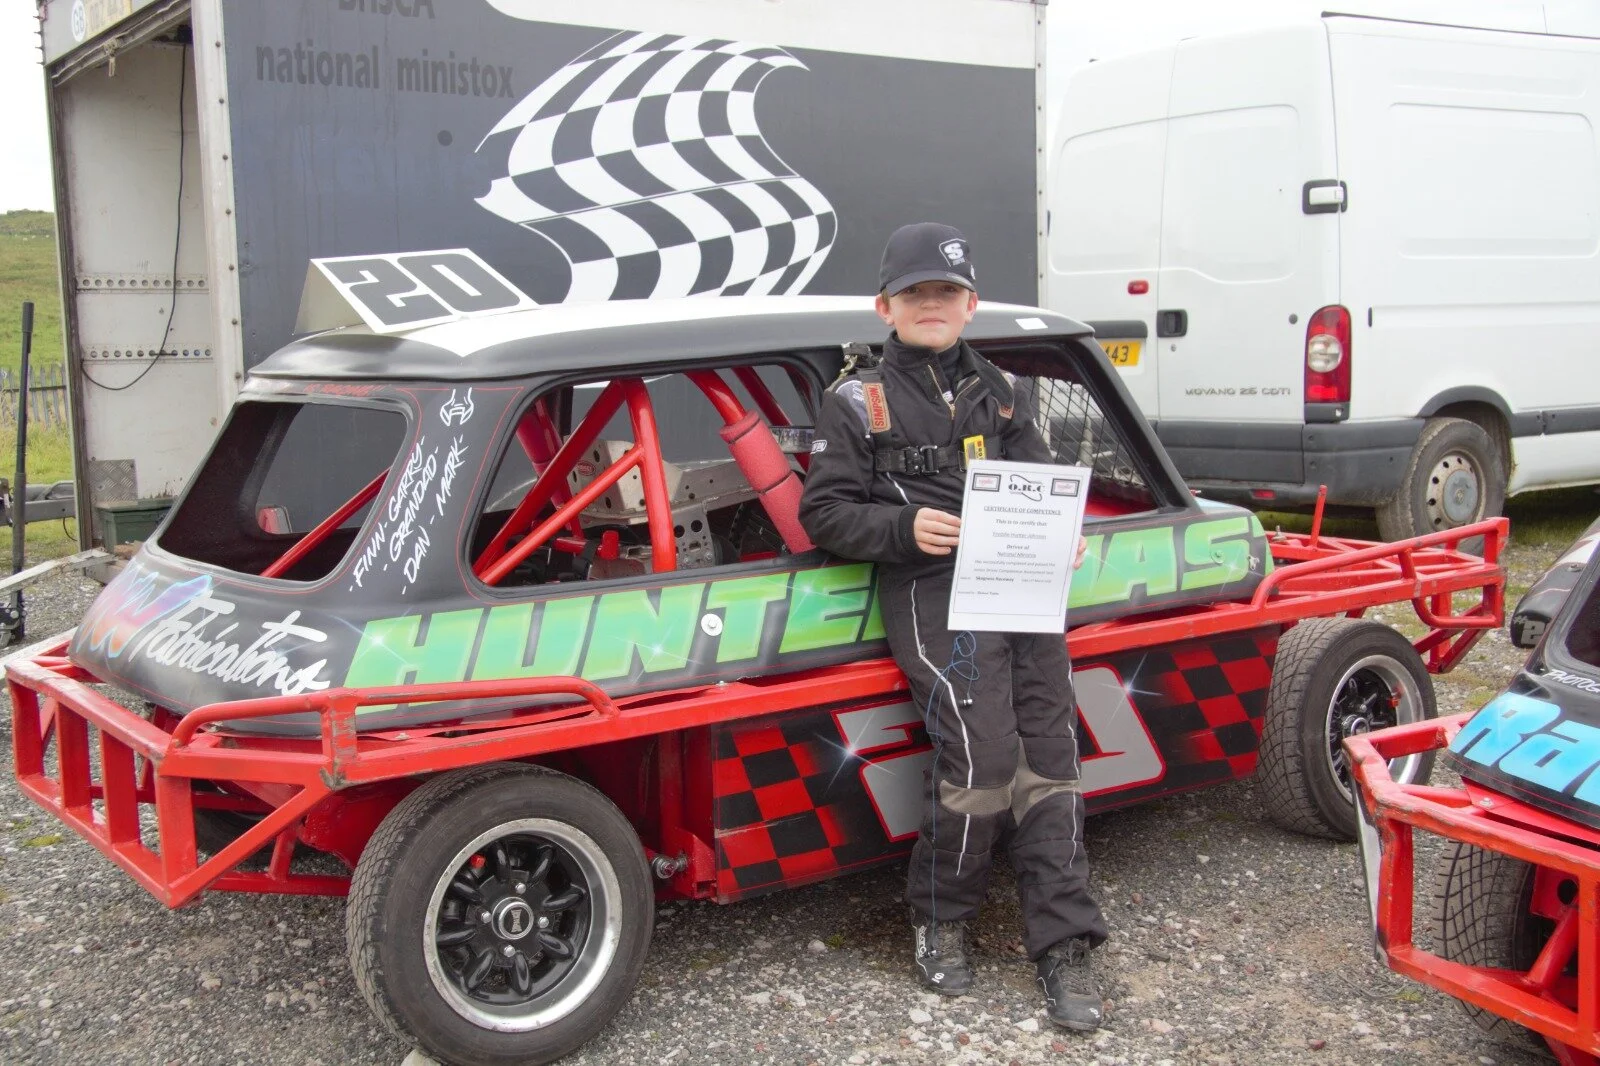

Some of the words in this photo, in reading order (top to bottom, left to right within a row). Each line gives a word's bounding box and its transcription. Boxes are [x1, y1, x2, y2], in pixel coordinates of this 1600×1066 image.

[256, 38, 380, 89] national
[397, 48, 515, 98] ministox
[312, 253, 521, 326] 20
[868, 387, 885, 427] SIMPSON
[1185, 387, 1236, 396] MOVANO
[343, 563, 888, 713] HUNTE
